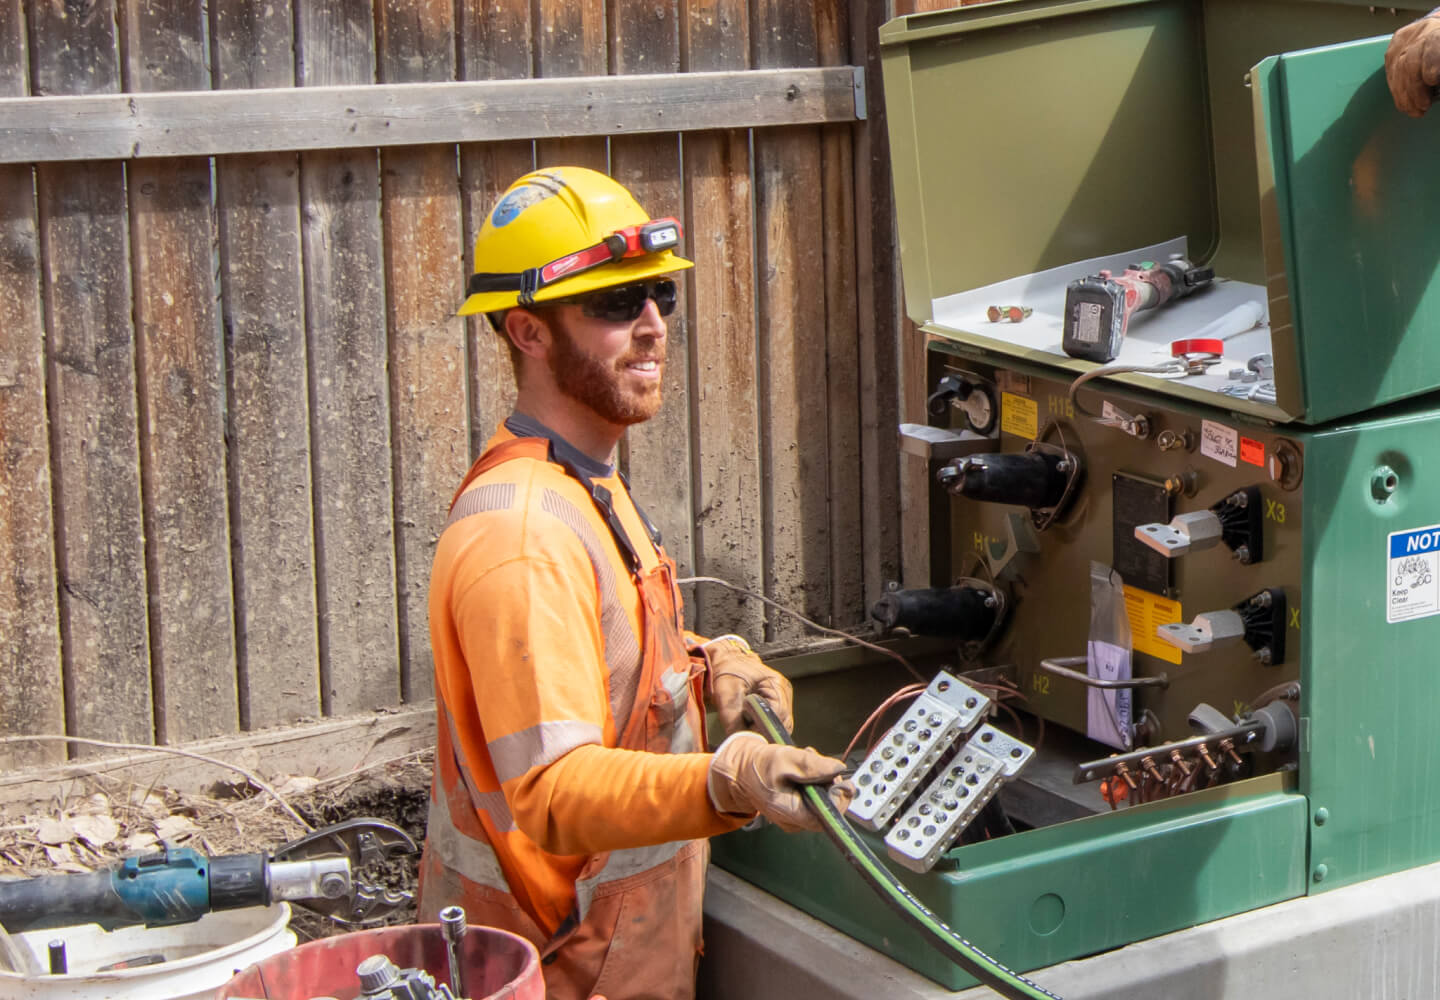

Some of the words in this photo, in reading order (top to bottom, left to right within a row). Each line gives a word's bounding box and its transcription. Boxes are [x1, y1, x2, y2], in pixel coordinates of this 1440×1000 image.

[1266, 498, 1285, 523] X3
[1391, 588, 1409, 597] Keep
[1391, 597, 1409, 605] Clear
